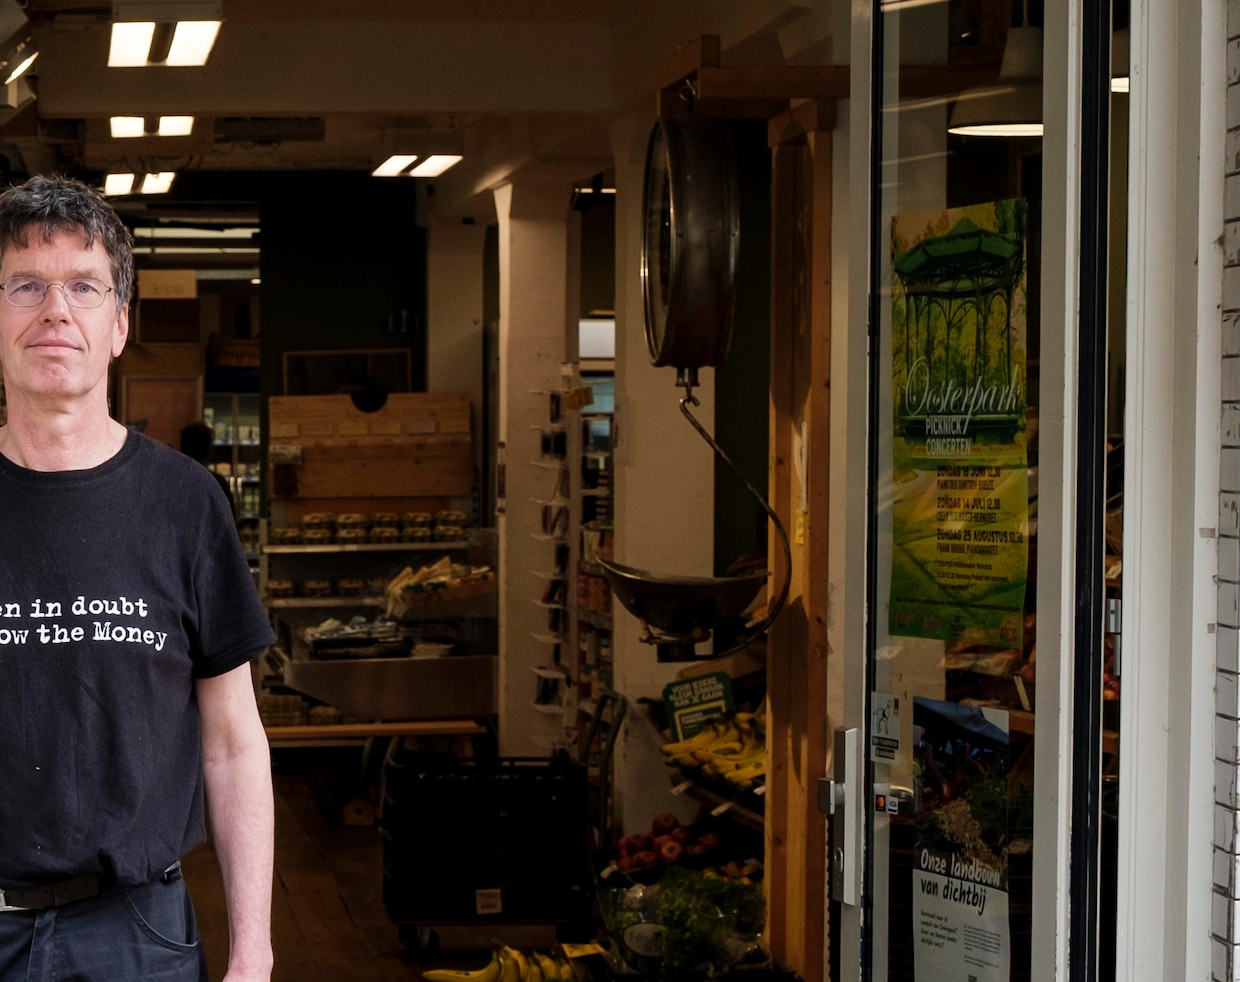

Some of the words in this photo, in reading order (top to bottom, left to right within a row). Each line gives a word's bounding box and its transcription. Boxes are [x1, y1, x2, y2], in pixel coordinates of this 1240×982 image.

[902, 356, 1020, 434] Oosterpark
[926, 416, 962, 435] PICKNICK
[926, 438, 971, 456] CONCERTEN
[937, 498, 961, 509] ZONDAG
[972, 498, 986, 510] JULI
[987, 498, 1000, 510] 12.30
[937, 529, 962, 541] ZONDAG
[964, 530, 971, 542] 25
[974, 531, 1008, 543] AUGUSTUS
[29, 598, 62, 618] in
[71, 596, 148, 618] doubt
[36, 624, 85, 644] the
[92, 621, 167, 651] Money
[920, 848, 947, 874] Onze
[950, 852, 1000, 888] landbouw
[920, 878, 938, 897] van
[942, 876, 987, 916] dichtbij
